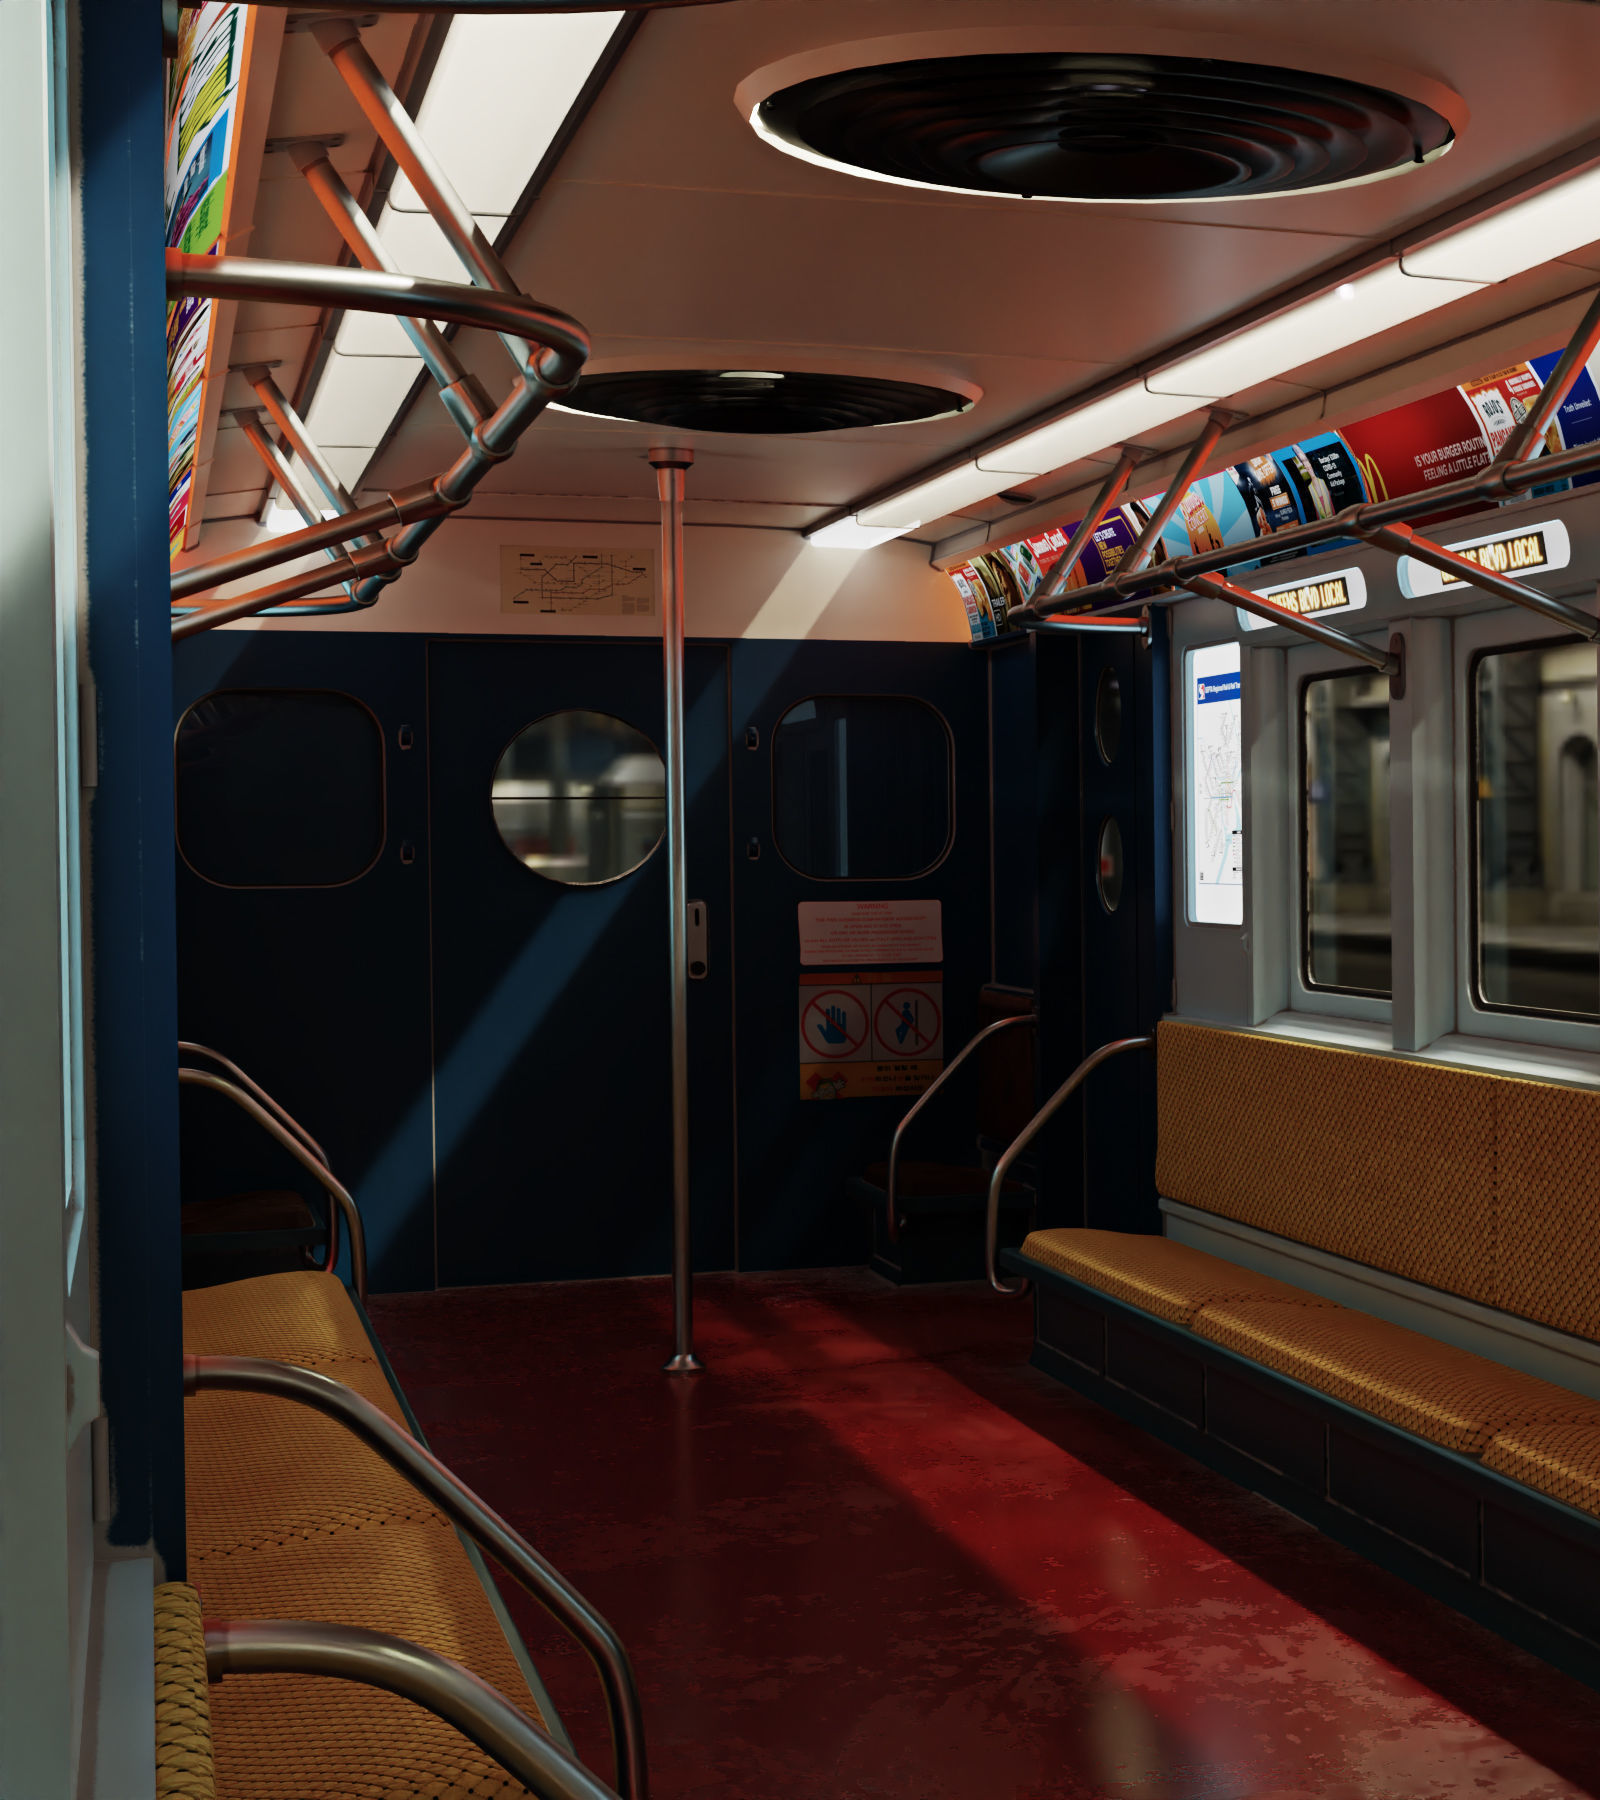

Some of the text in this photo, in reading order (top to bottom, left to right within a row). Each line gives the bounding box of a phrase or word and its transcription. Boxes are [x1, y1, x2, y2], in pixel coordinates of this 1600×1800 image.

[1413, 456, 1423, 468] IS
[1421, 450, 1439, 466] YOUR
[1437, 442, 1462, 461] BURGER
[1423, 463, 1449, 480] FEELING
[1447, 463, 1454, 474] A
[1453, 458, 1474, 474] LITTLE
[1508, 535, 1544, 570] LOCAL
[1297, 585, 1320, 614] BLVD
[1319, 579, 1348, 609] LOCAL
[856, 902, 889, 911] WARNING
